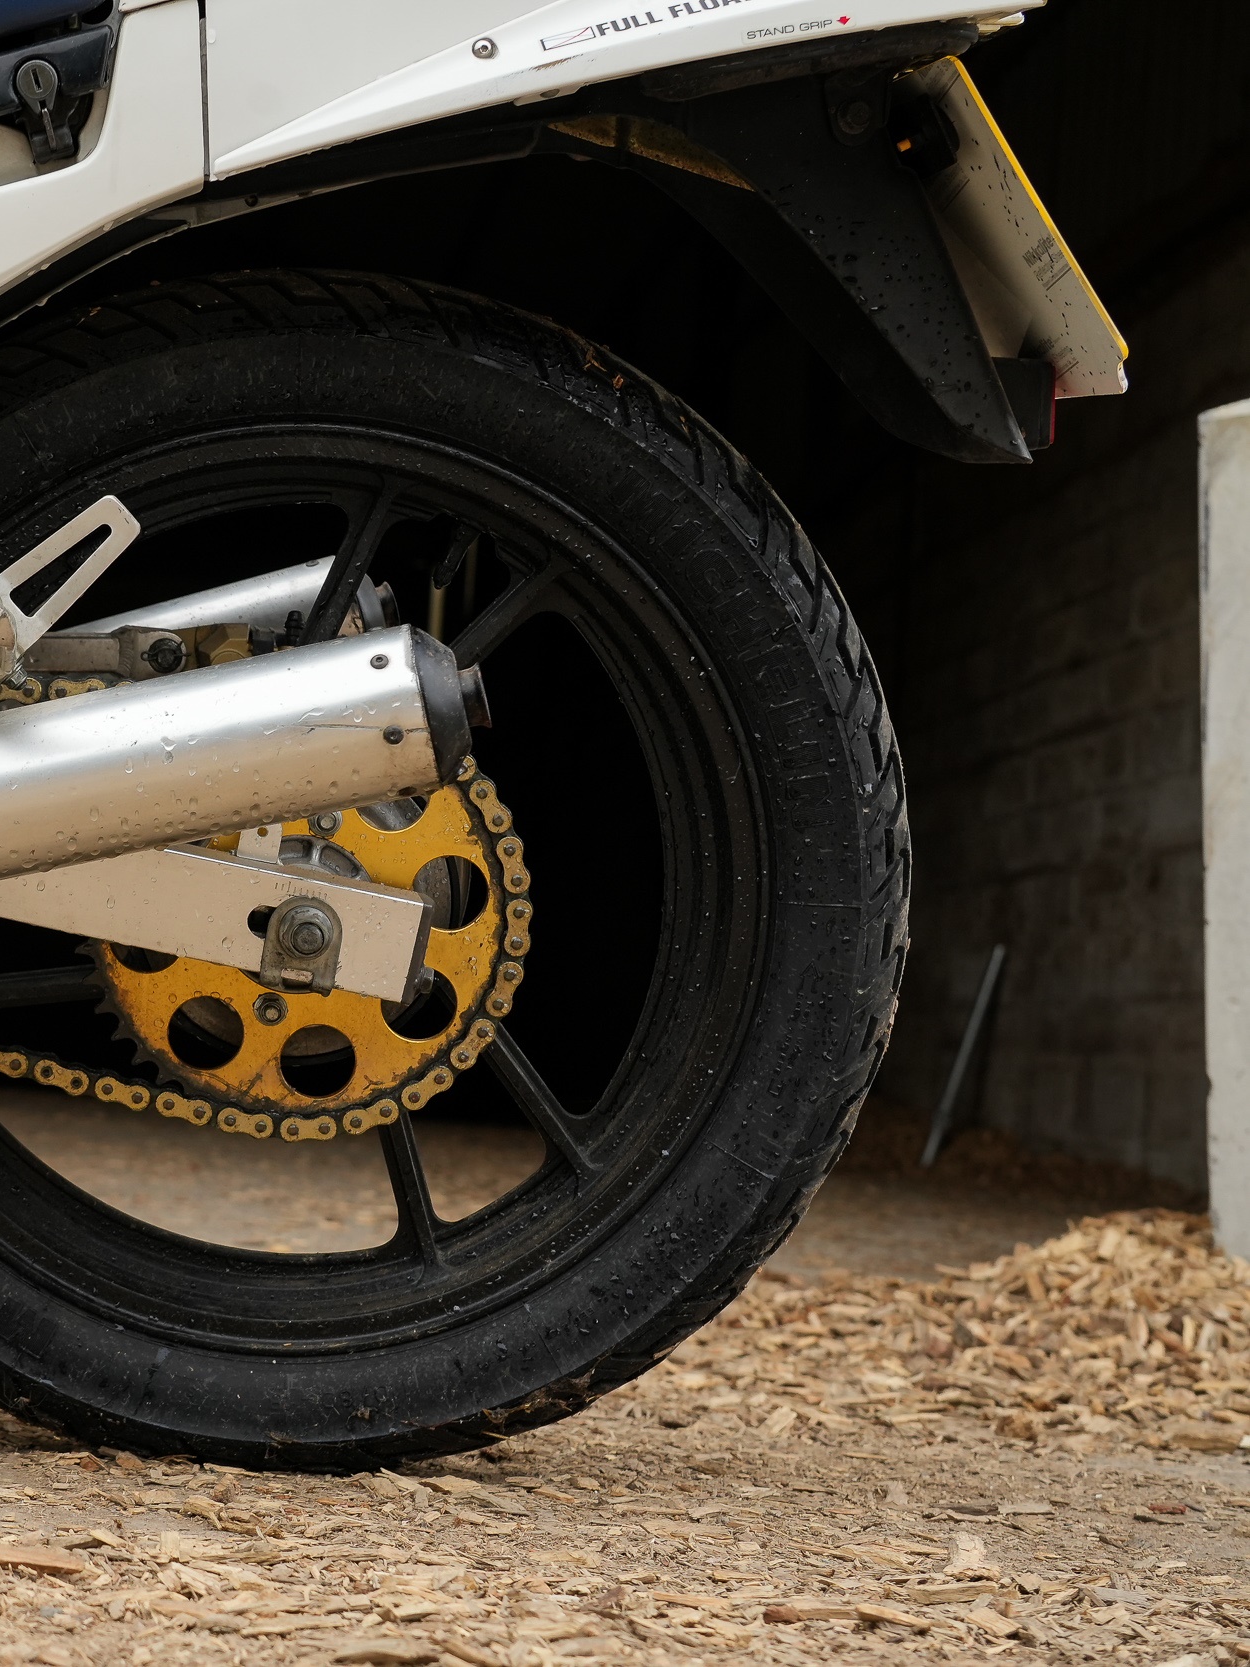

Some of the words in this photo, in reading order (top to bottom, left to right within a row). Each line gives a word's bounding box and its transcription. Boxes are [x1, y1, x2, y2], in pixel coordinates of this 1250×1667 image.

[596, 12, 662, 36] FULL
[746, 25, 796, 40] STAND
[799, 19, 834, 32] GRIP
